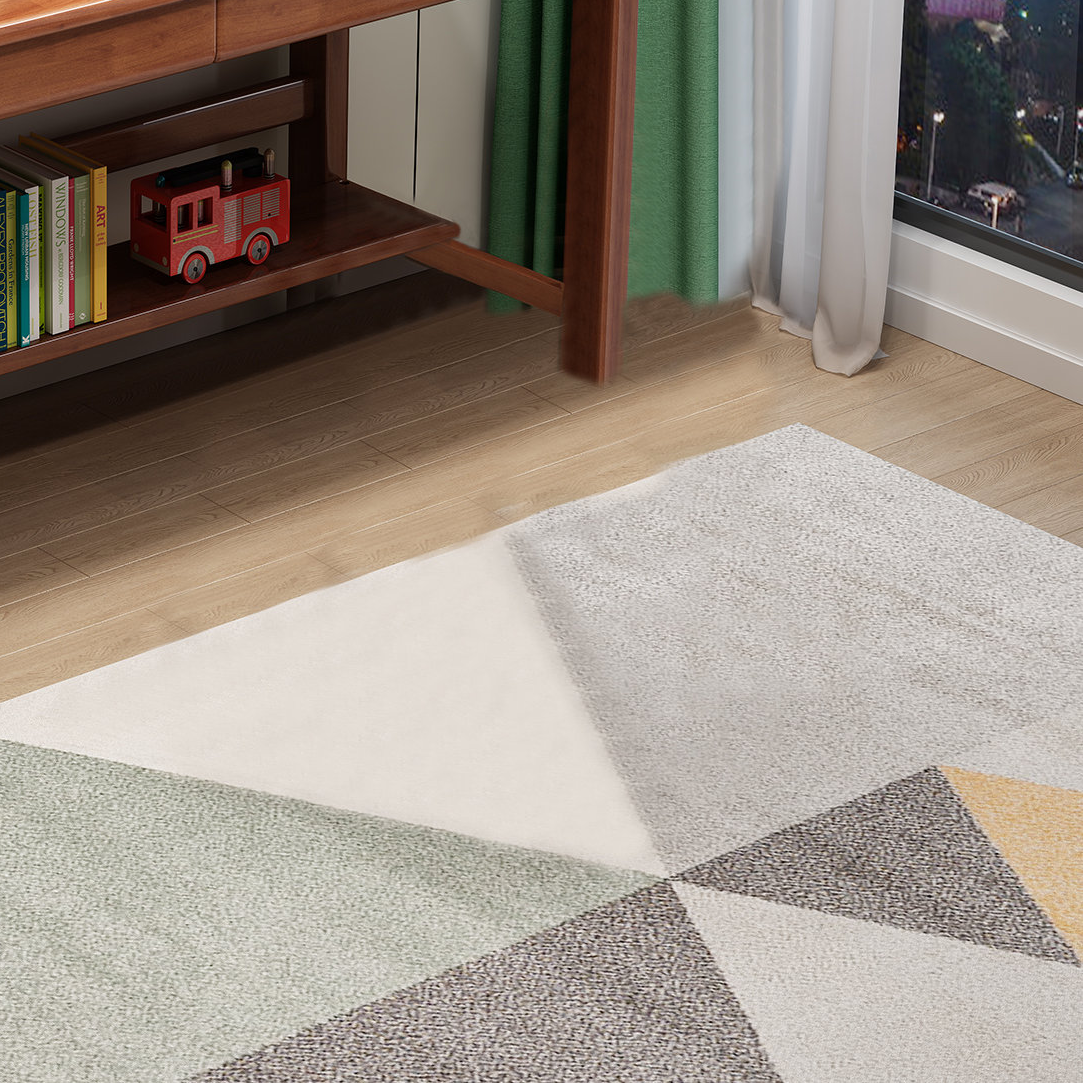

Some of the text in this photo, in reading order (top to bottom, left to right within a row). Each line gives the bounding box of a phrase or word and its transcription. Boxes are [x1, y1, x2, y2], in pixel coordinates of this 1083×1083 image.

[54, 182, 66, 247] WINDOWS
[96, 205, 105, 228] ART
[8, 271, 14, 279] in
